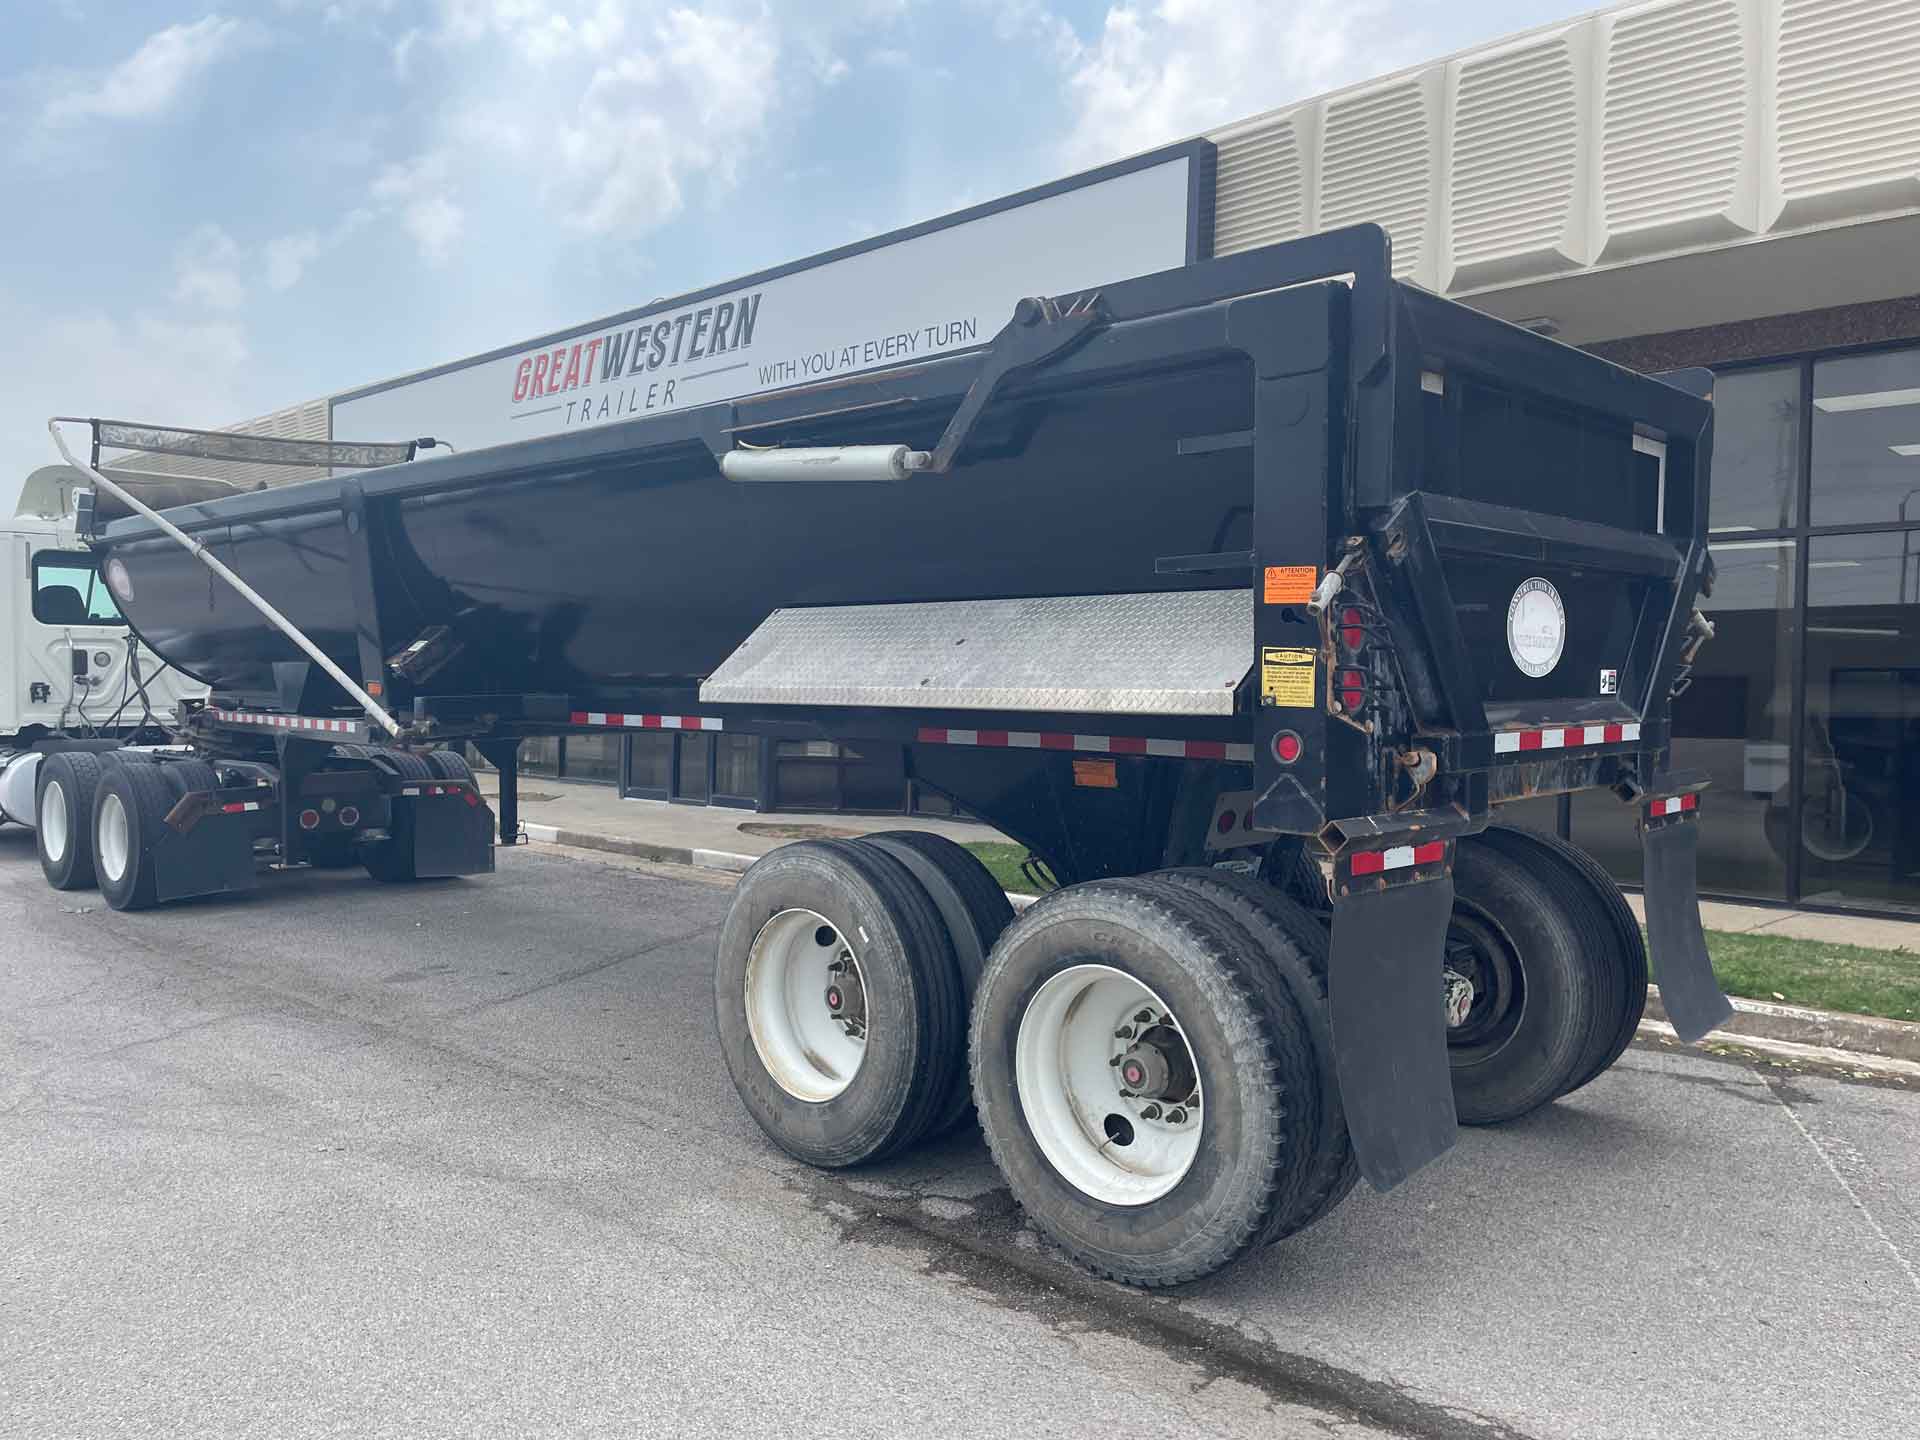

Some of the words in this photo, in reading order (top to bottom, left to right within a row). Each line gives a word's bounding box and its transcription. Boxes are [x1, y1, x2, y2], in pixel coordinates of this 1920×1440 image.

[758, 359, 796, 385] WITH
[801, 350, 835, 374] YOU
[839, 345, 860, 368] AT
[864, 330, 920, 363] EVERY
[924, 317, 977, 349] TURN
[566, 379, 676, 425] TRAILER
[1280, 567, 1314, 575] ATTENTION
